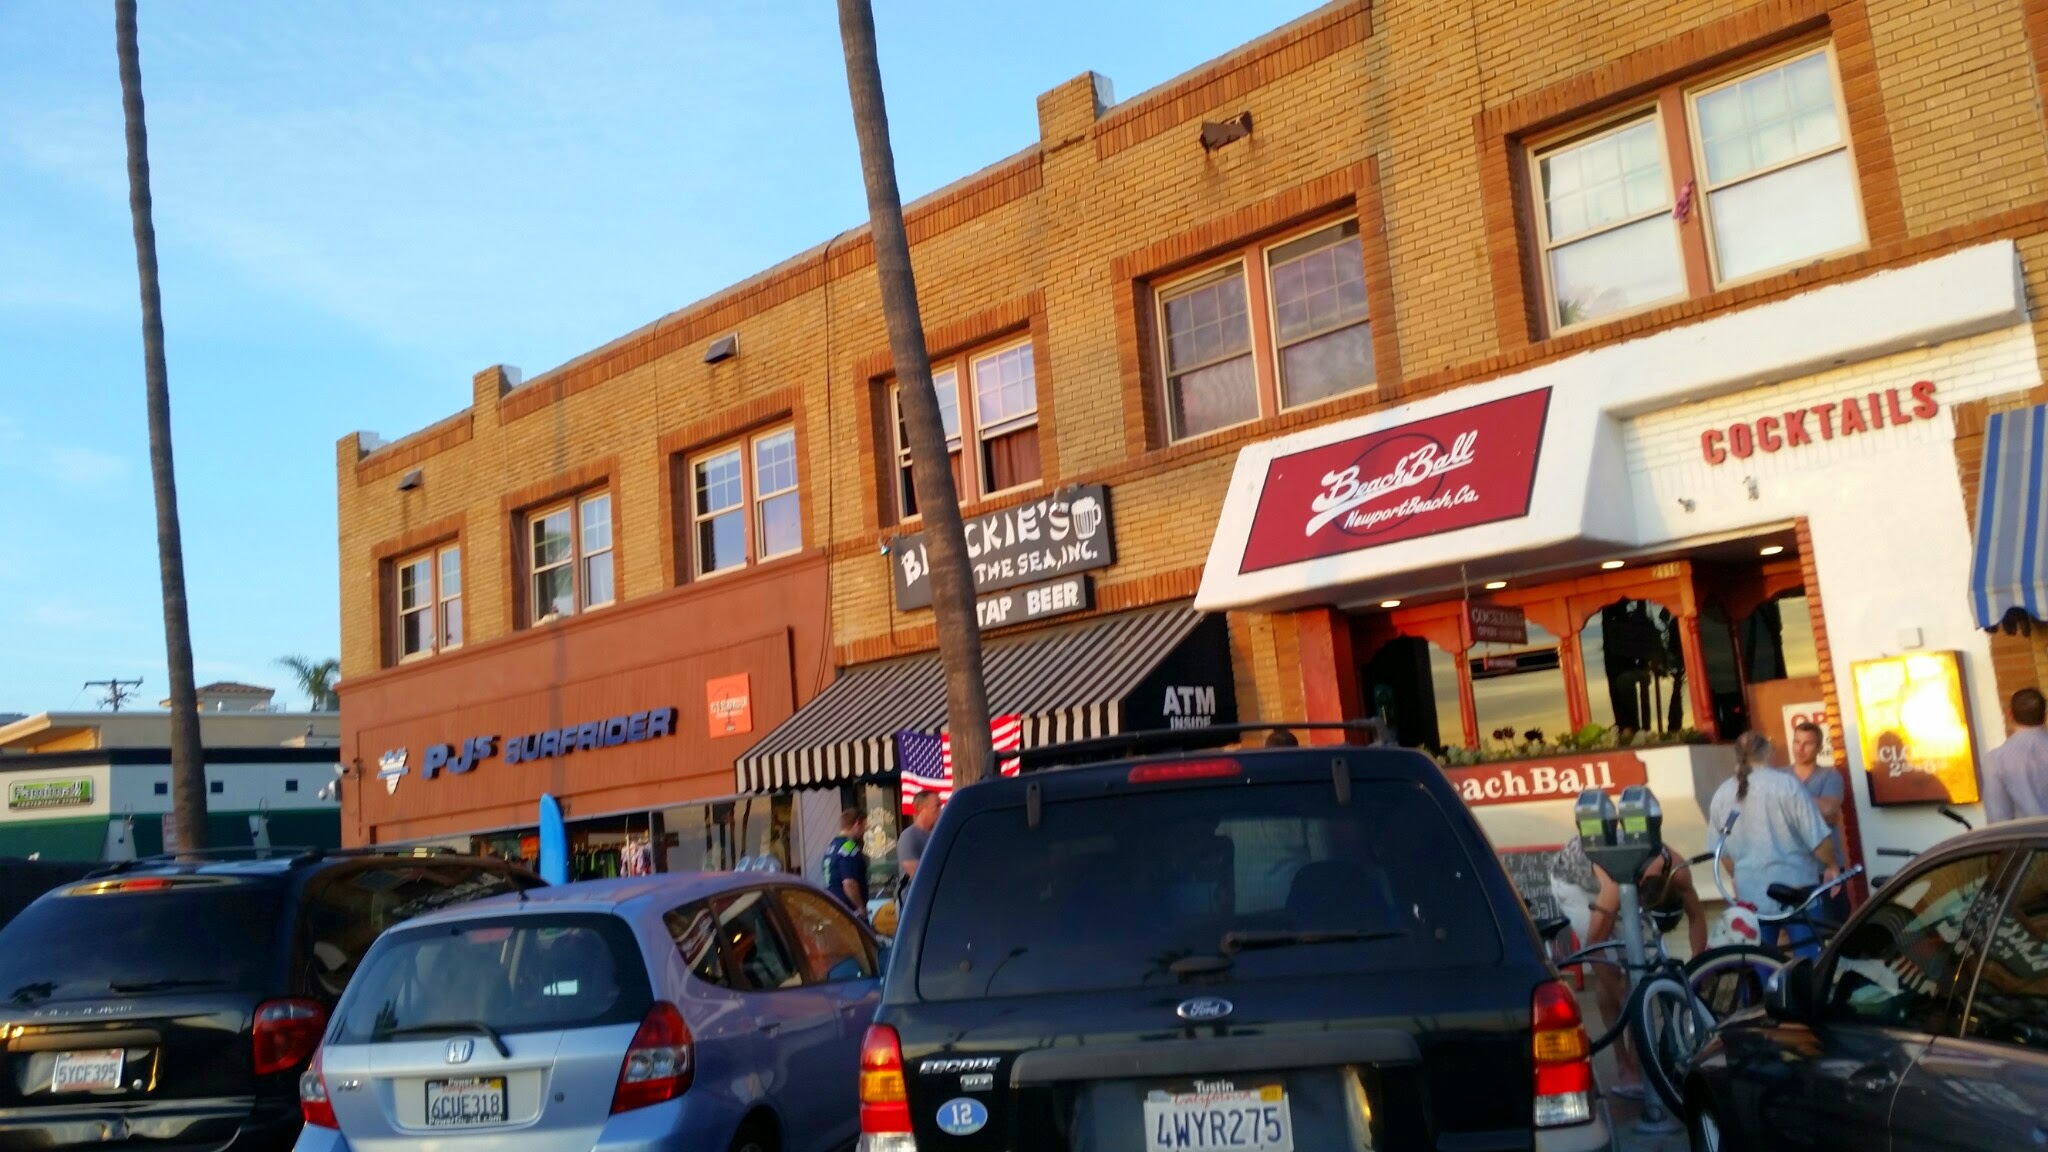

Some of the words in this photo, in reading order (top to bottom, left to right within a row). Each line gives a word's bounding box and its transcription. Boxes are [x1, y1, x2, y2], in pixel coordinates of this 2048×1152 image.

[1700, 380, 1939, 466] COCKTAILS
[1312, 455, 1410, 514] Beach
[1406, 429, 1479, 481] Ball
[901, 501, 1071, 588] BLCKIE'S
[974, 556, 1015, 584] THE
[976, 596, 1013, 627] TAP
[1026, 580, 1079, 616] BEER
[1163, 685, 1216, 716] ATM
[504, 707, 676, 765] SURFRIDER
[1530, 761, 1616, 795] Ball
[1190, 1001, 1220, 1016] Ford
[58, 1063, 117, 1084] 5YCF395
[1193, 1079, 1235, 1093] Tustin
[431, 1092, 500, 1119] 6CUE318
[952, 1103, 973, 1126] 12
[1157, 1107, 1282, 1148] 4WYR275
